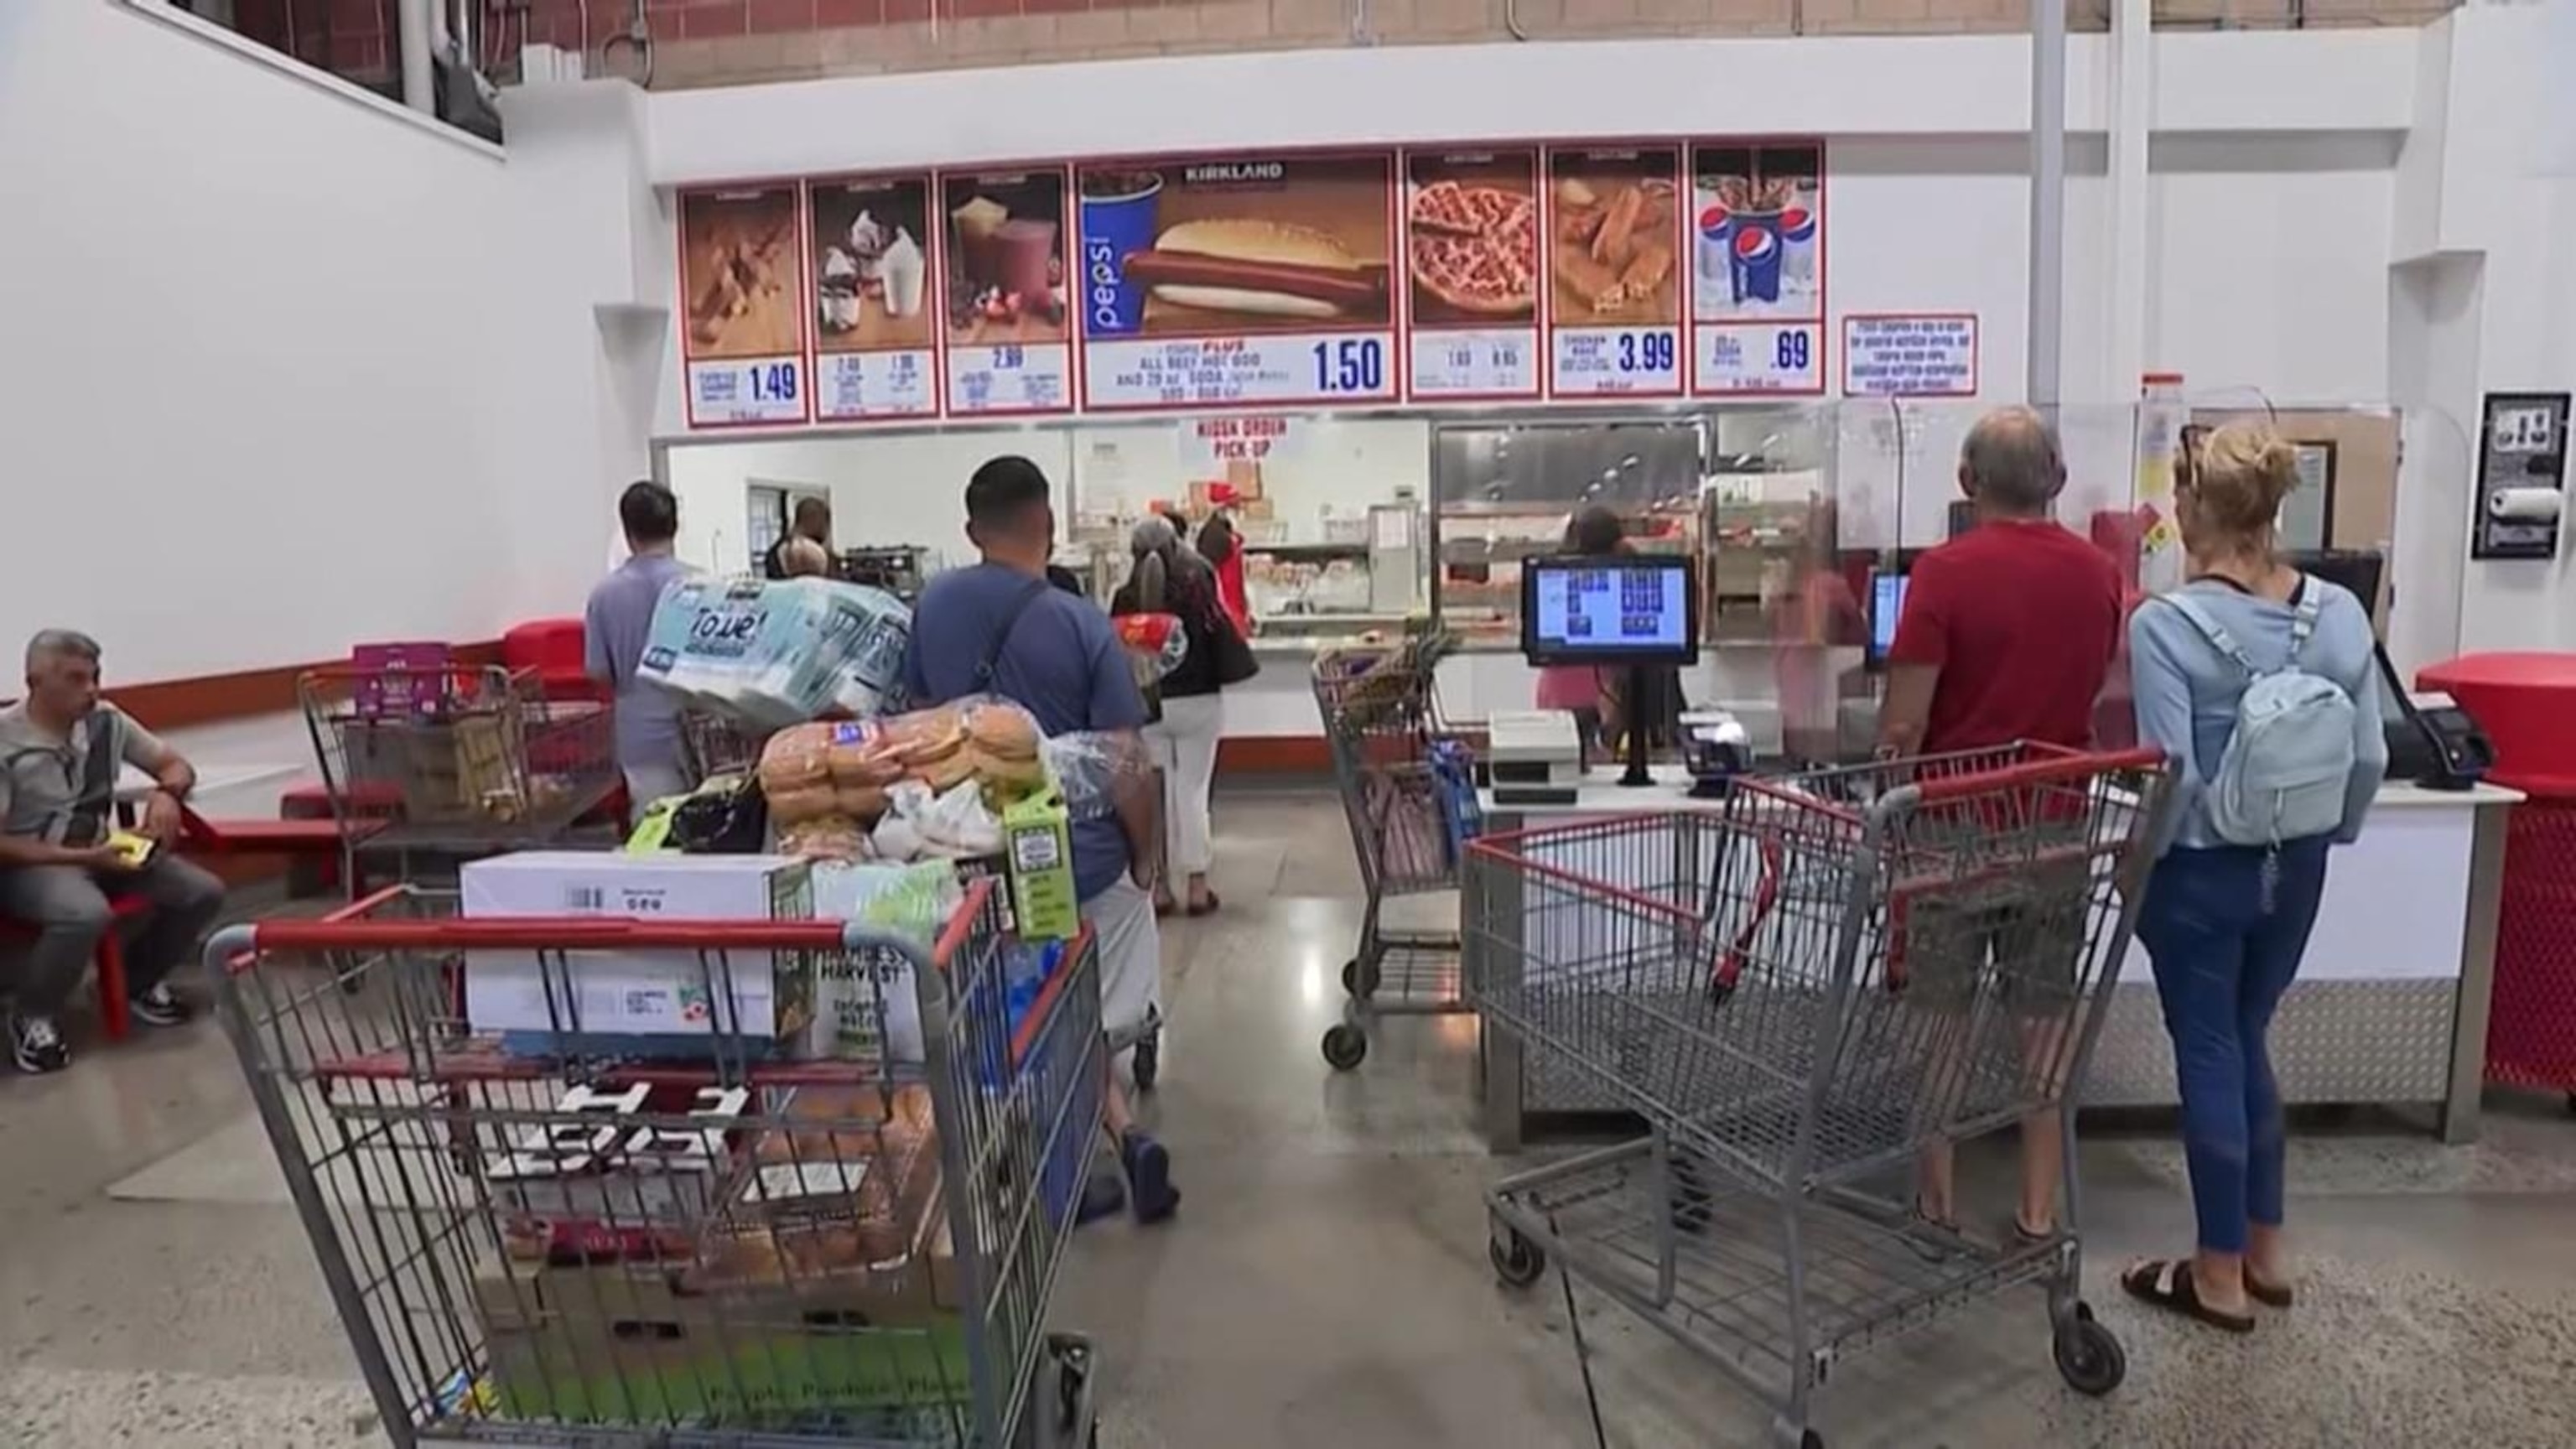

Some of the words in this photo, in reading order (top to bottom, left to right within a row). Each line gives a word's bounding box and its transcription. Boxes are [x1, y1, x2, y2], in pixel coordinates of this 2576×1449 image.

[1185, 162, 1284, 182] KIRKLAND
[1085, 236, 1123, 329] pepsi
[1313, 339, 1382, 391] 1.50
[1618, 332, 1674, 371] 3.99
[1770, 330, 1809, 369] .69
[750, 362, 796, 400] 1.49
[1197, 420, 1238, 437] KIOSK
[1243, 418, 1286, 436] ORDER
